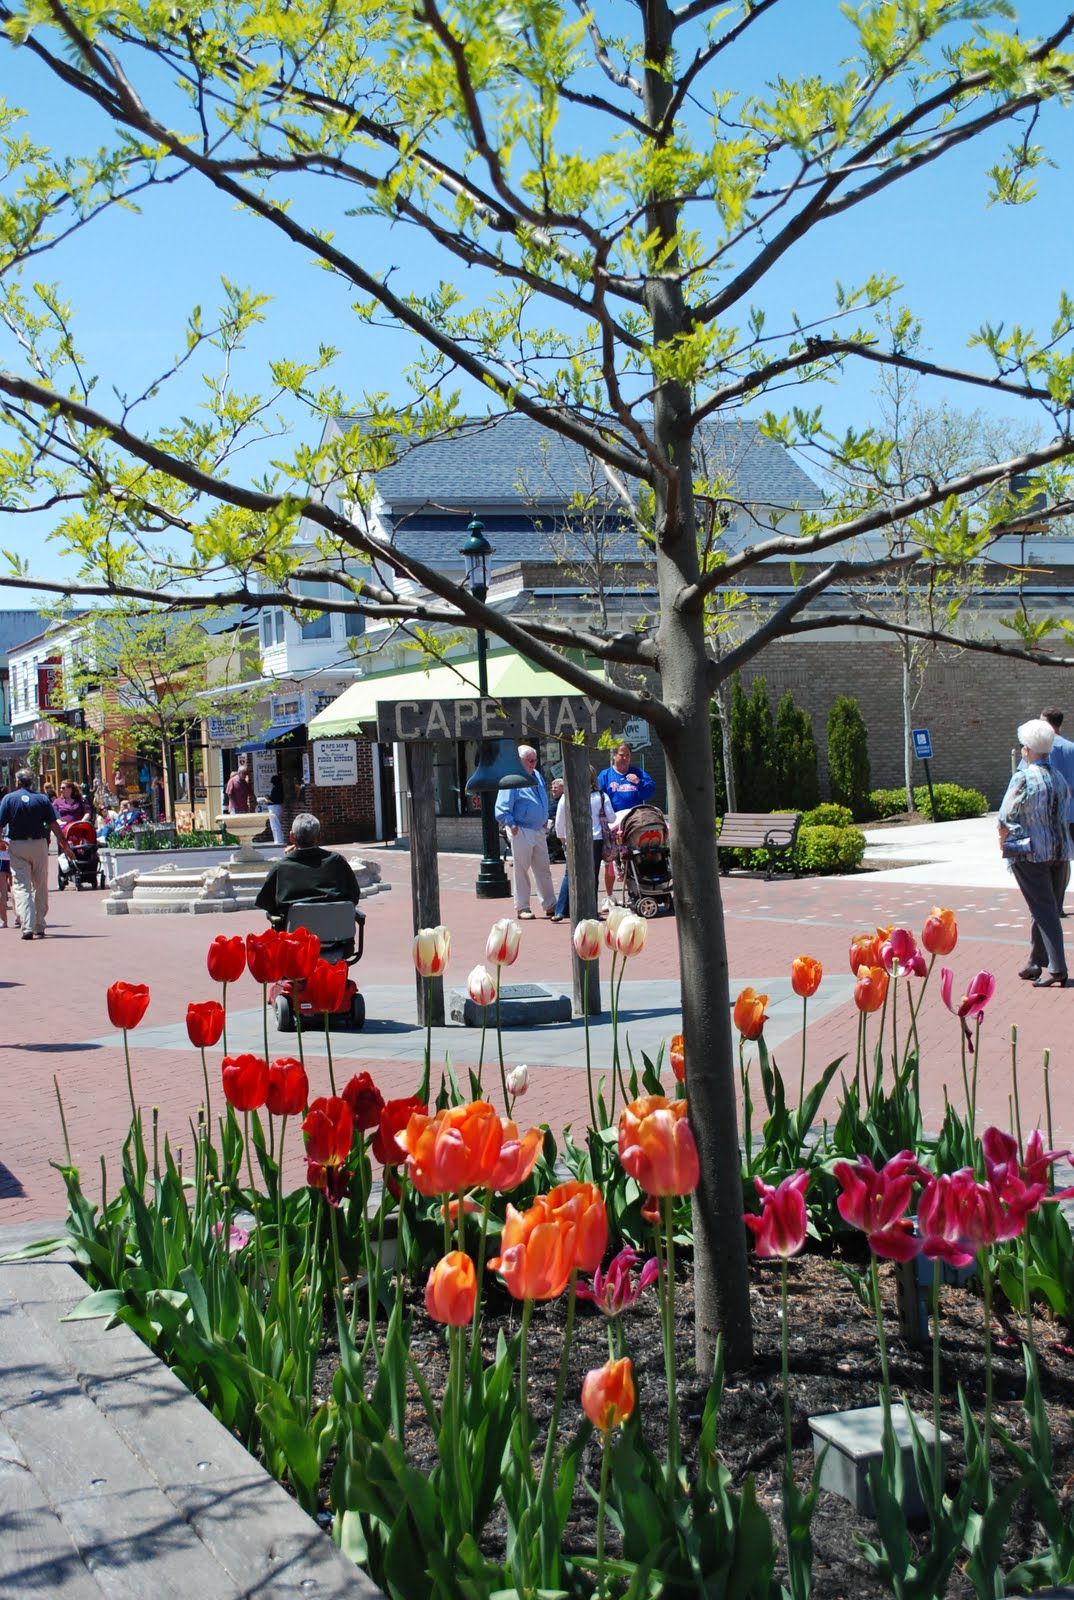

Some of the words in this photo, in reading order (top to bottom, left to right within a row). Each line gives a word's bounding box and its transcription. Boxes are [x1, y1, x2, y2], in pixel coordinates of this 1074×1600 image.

[394, 699, 505, 739] CAPE
[520, 697, 600, 735] MAY
[320, 743, 335, 752] CAPE
[336, 743, 349, 752] MAY
